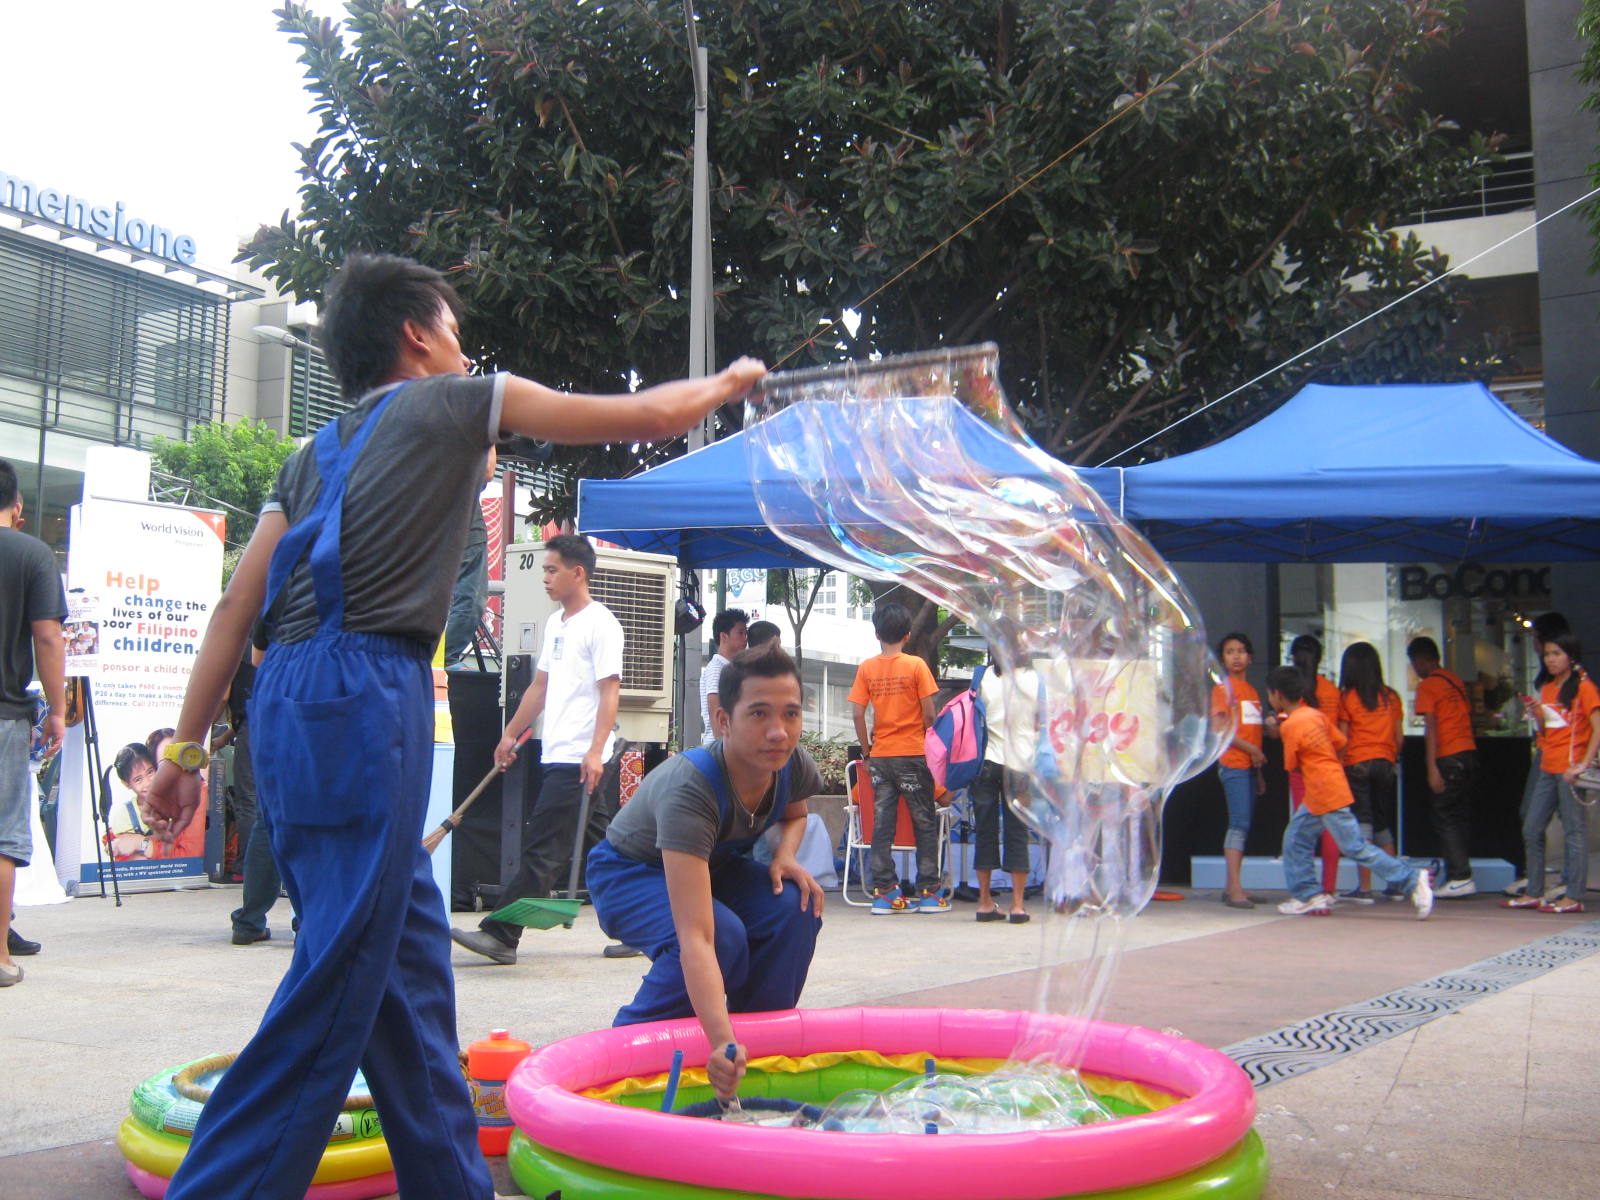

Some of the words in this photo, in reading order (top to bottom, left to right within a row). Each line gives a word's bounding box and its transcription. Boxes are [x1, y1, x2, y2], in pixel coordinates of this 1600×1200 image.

[141, 521, 172, 534] World
[173, 525, 204, 538] Vision
[520, 553, 534, 570] 20
[106, 570, 160, 596] Help
[124, 594, 182, 613] change
[186, 601, 207, 611] the
[113, 607, 142, 619] lives
[148, 611, 161, 620] of
[166, 613, 189, 622] our
[137, 622, 198, 639] Filipino
[113, 636, 200, 655] children.
[153, 664, 178, 674] child
